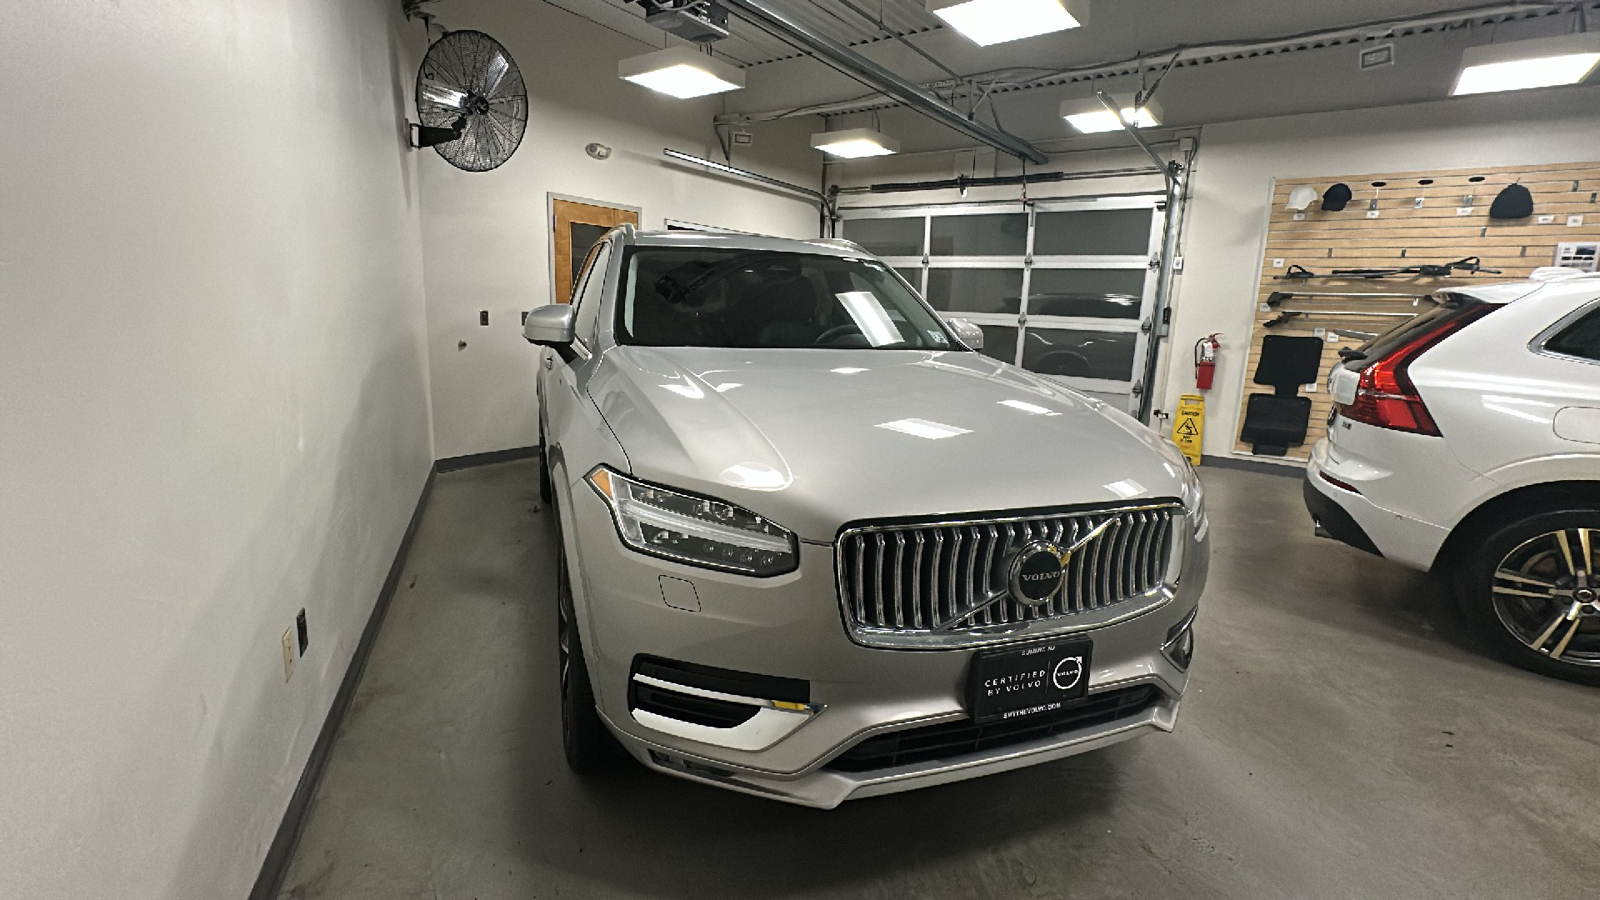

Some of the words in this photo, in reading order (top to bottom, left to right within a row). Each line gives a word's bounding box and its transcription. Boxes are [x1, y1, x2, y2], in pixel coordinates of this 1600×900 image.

[1022, 571, 1060, 581] VOLVO
[984, 669, 1046, 687] CERTIFIED
[1057, 669, 1079, 677] VOLVO
[987, 686, 1001, 697] BY
[1006, 680, 1041, 692] VOLVO
